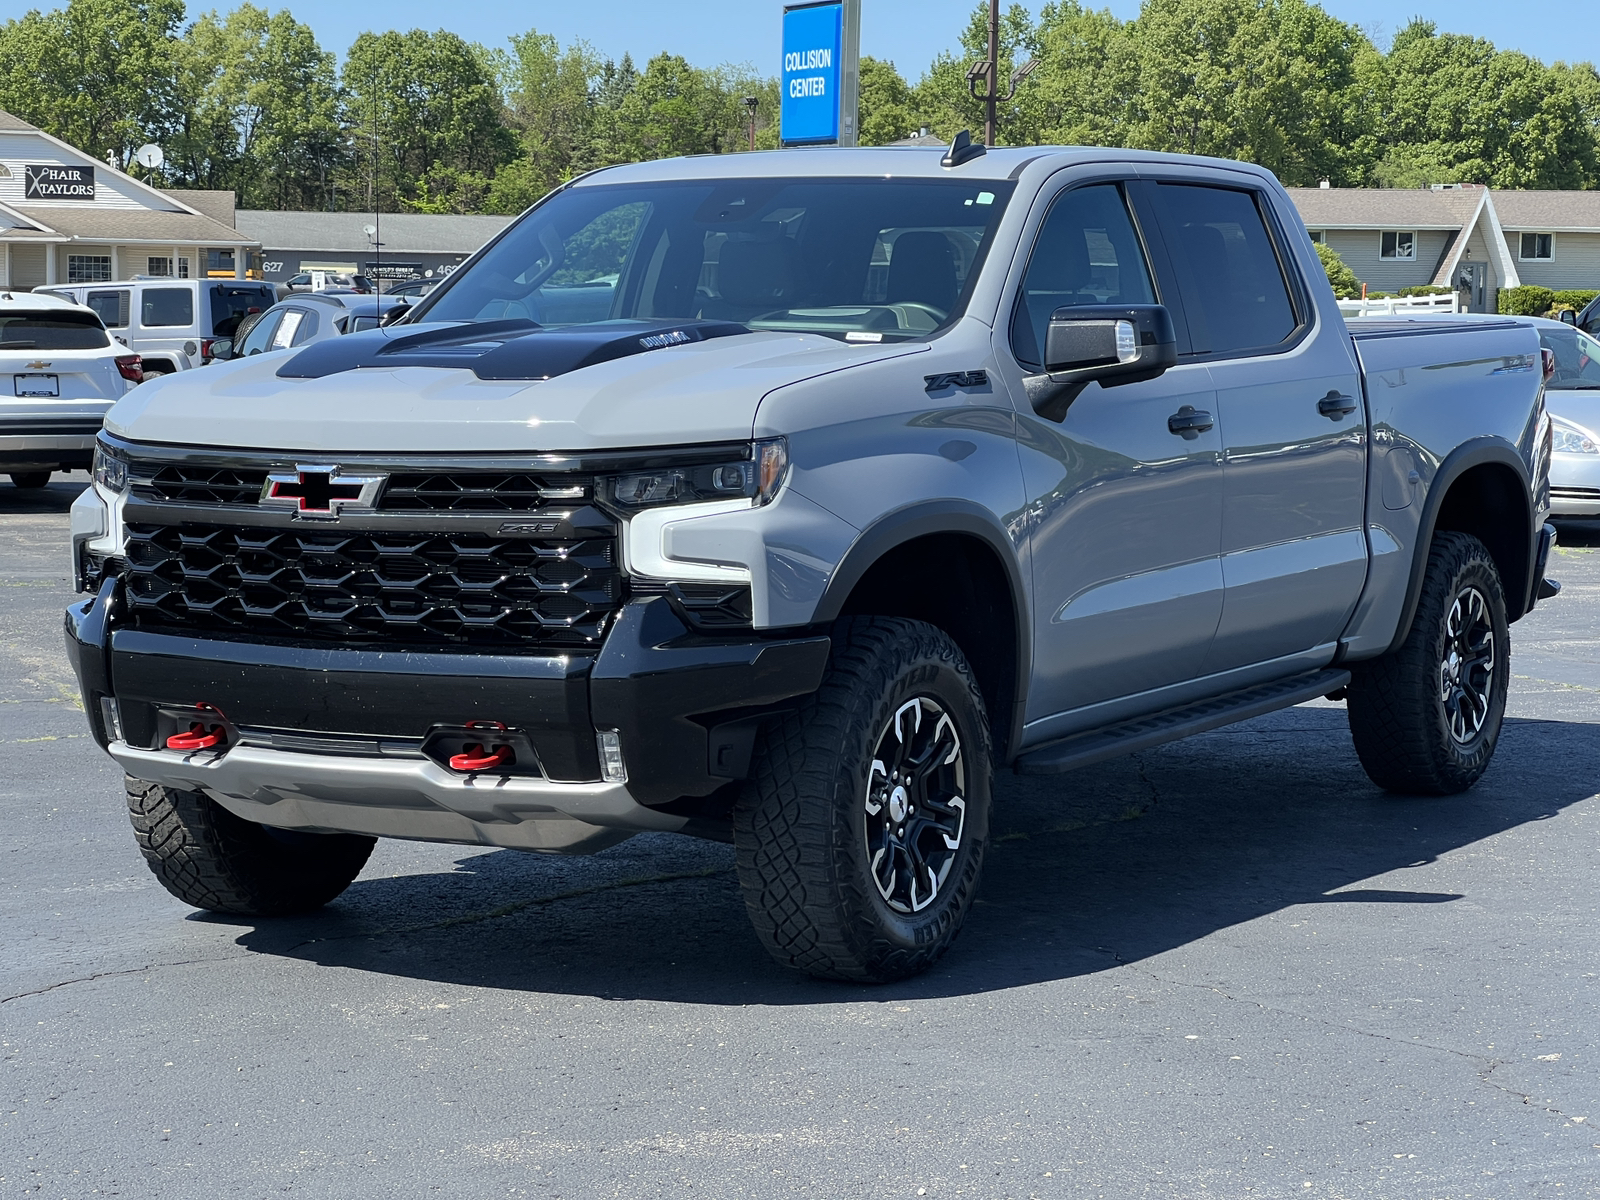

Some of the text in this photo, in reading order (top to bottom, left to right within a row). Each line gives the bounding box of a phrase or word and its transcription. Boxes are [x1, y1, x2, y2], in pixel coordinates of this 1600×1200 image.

[785, 48, 831, 72] COLLISION
[790, 76, 825, 98] CENTER
[49, 169, 81, 181] HAIR
[40, 183, 94, 195] TAYLORS
[262, 261, 284, 273] 627
[923, 369, 987, 392] ZR2
[497, 522, 560, 533] ZR2
[913, 838, 983, 945] WRANGLER
